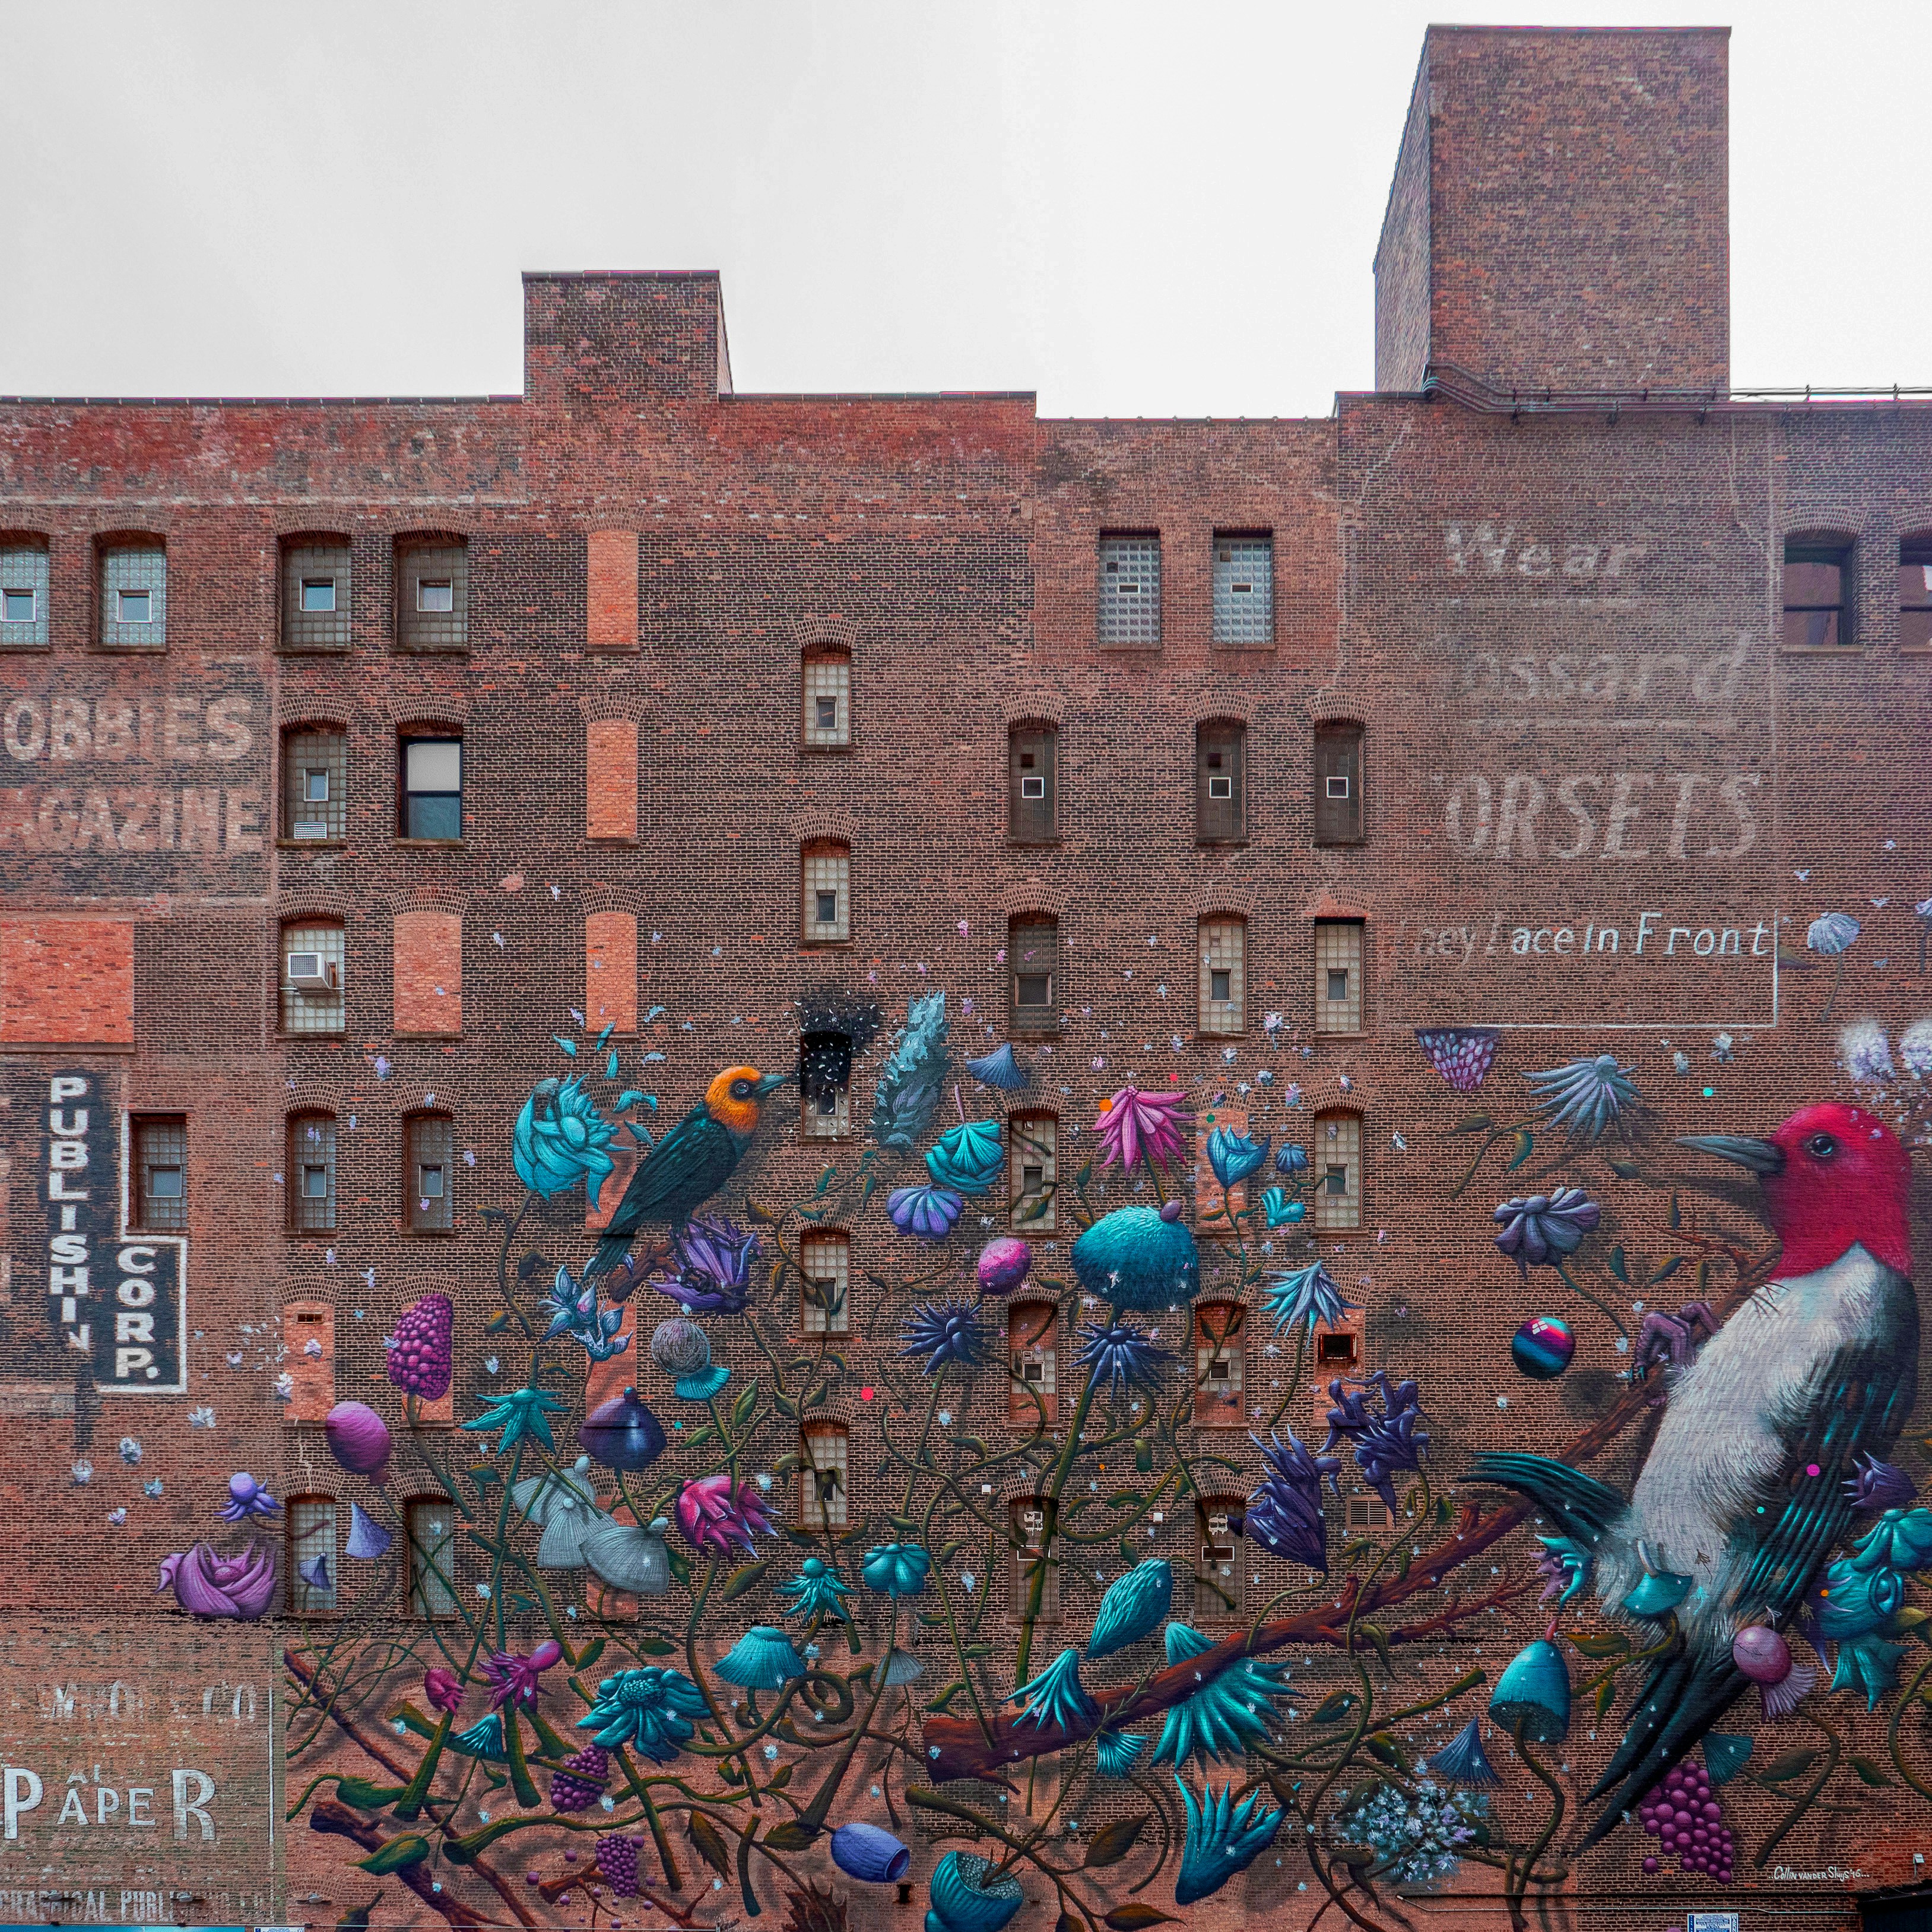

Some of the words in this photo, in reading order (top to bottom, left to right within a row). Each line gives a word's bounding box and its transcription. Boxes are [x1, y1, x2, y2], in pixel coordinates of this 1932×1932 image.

[1444, 520, 1649, 578] Wear
[1445, 773, 1761, 859] ORSETS
[1635, 911, 1771, 956] Front
[115, 1247, 161, 1379] CORP.
